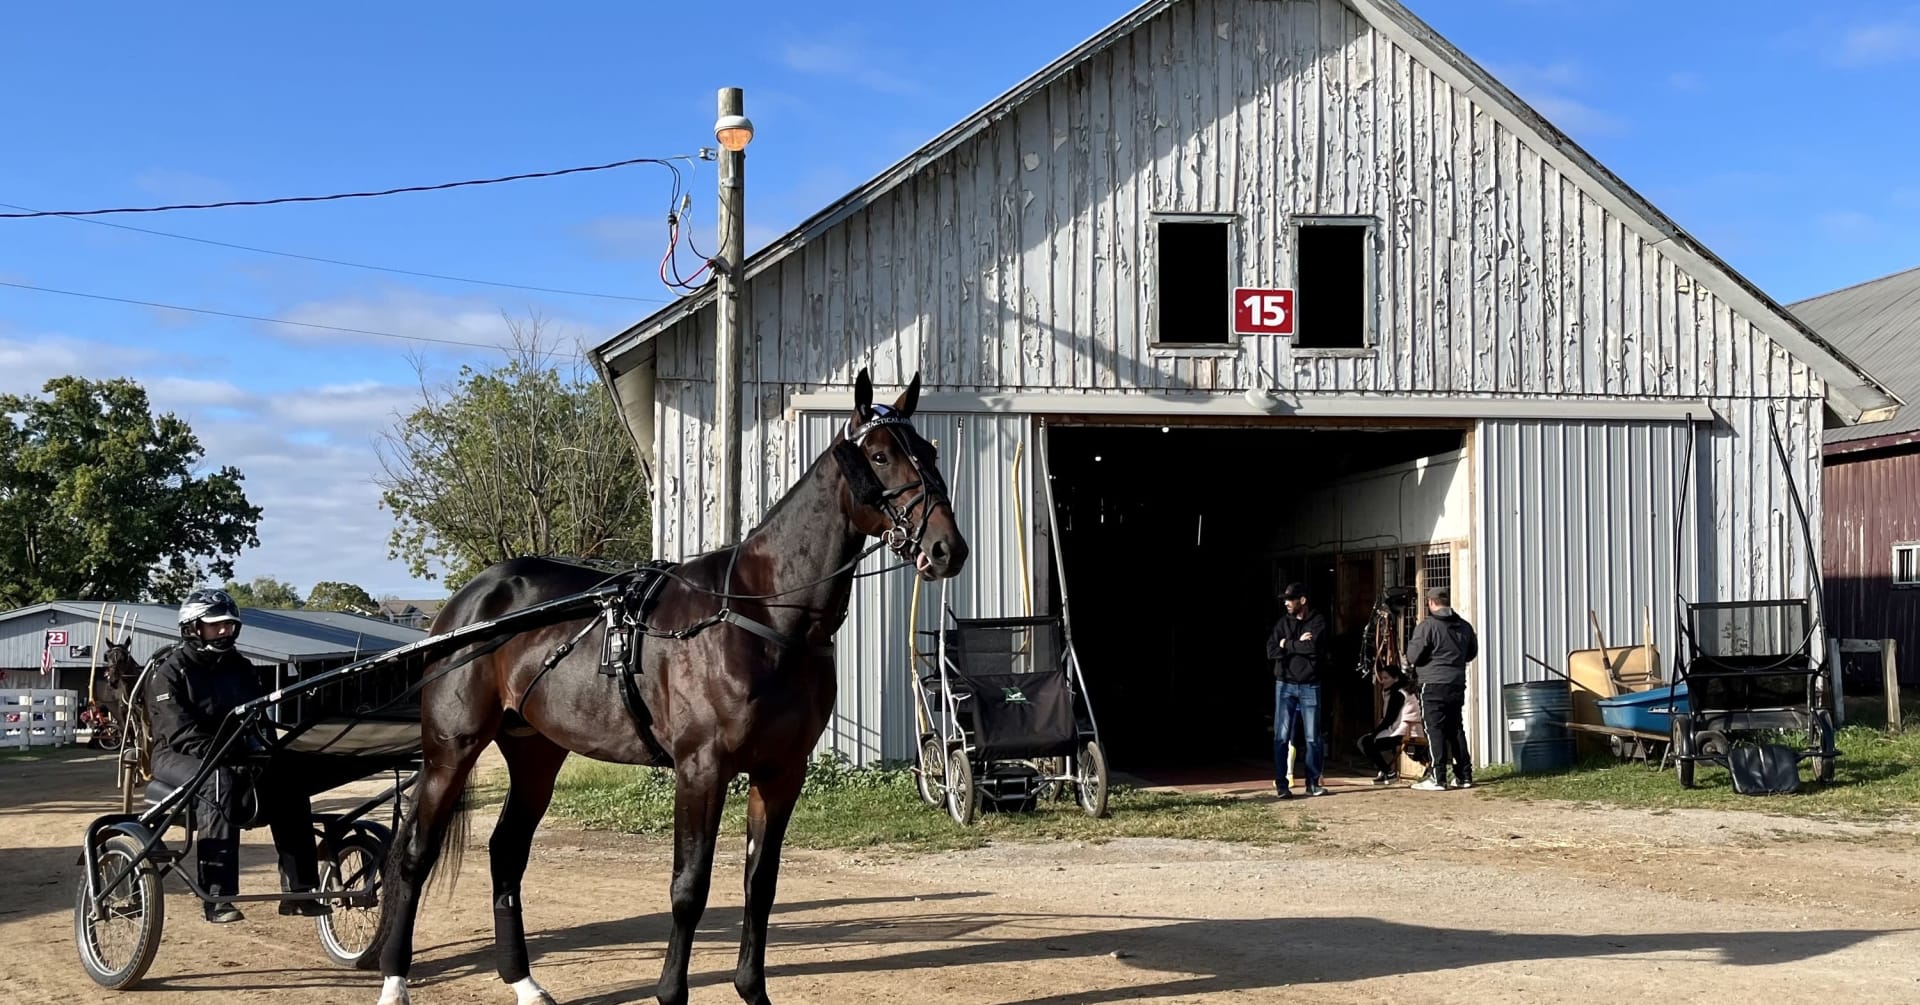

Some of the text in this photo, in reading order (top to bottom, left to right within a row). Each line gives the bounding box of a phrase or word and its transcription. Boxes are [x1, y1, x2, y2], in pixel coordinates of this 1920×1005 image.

[1243, 295, 1285, 326] 15
[865, 416, 900, 429] TACTICAL
[48, 632, 64, 643] 23
